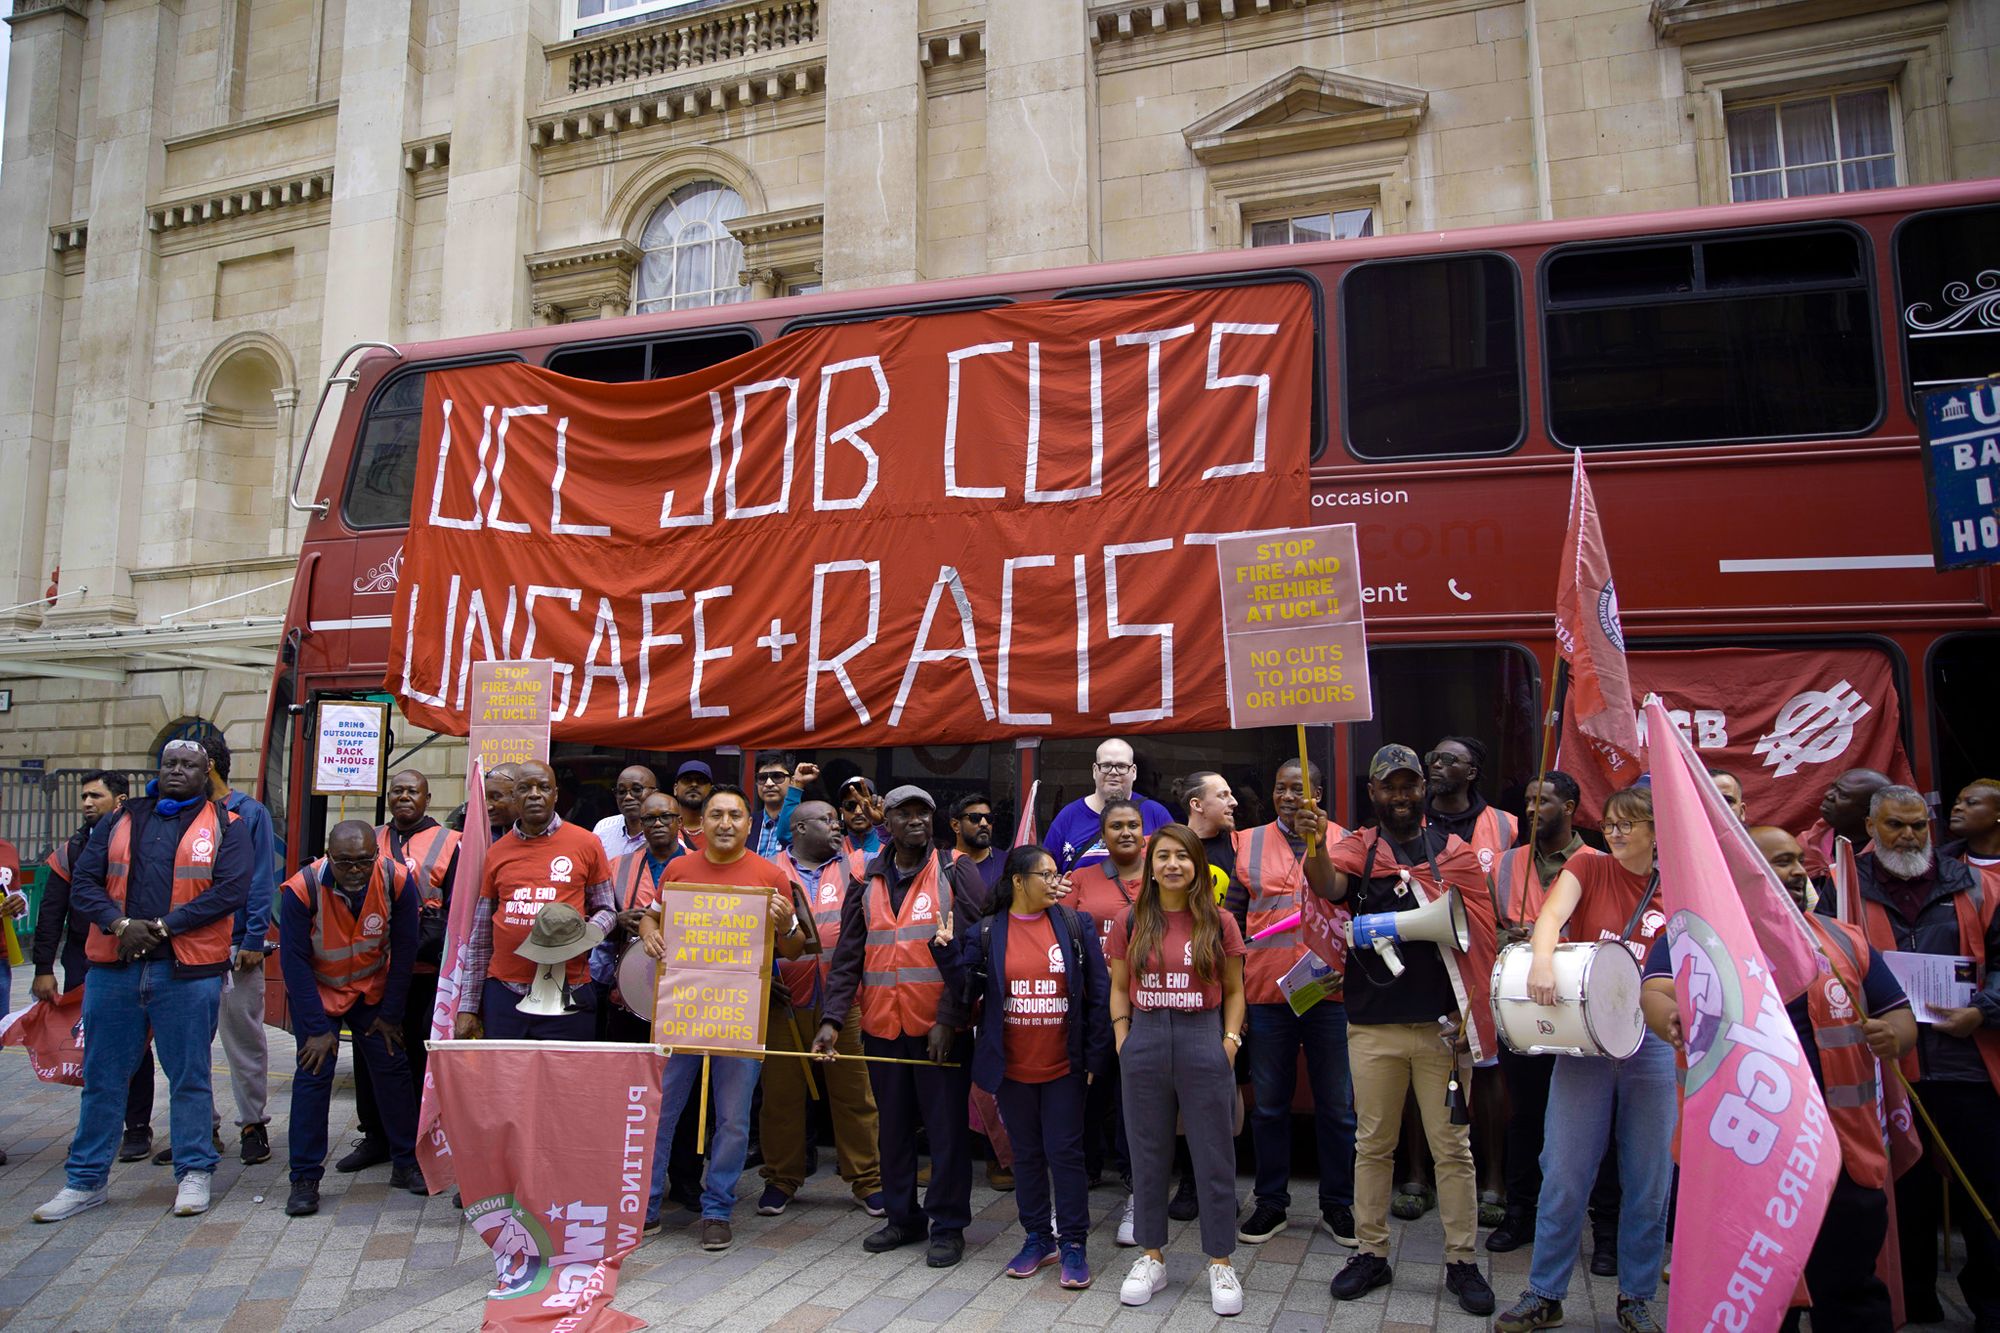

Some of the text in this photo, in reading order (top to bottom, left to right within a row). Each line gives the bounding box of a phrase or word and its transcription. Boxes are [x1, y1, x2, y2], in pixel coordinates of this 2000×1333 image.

[428, 322, 1280, 537] UCL JOB CUTS
[1310, 488, 1409, 507] occasion
[1256, 539, 1316, 561] STOP
[1236, 557, 1341, 583] FIRE-AND
[1247, 578, 1335, 601] -REHIRE
[1361, 582, 1408, 603] ent
[1246, 604, 1276, 623] AT
[1280, 600, 1324, 620] UCL
[1250, 644, 1343, 668] NO CUTS
[494, 667, 529, 679] STOP
[1255, 665, 1343, 688] TO JOBS
[481, 681, 542, 693] FIRE-AND
[1246, 684, 1356, 709] OR HOURS
[483, 709, 499, 720] AT
[503, 709, 528, 720] UCL
[323, 730, 379, 738] OUTSOURCED
[337, 739, 364, 747] STAFF
[481, 739, 535, 751] NO CUTS
[324, 756, 375, 765] IN-HOUSE
[336, 748, 363, 756] BACK
[483, 752, 498, 765] TO
[513, 887, 557, 900] UCL END
[693, 895, 741, 910] STOP
[673, 912, 759, 929] FIRE-AND
[680, 930, 750, 947] -REHIRE
[675, 947, 700, 962] AT
[703, 949, 738, 964] UCL
[1011, 980, 1057, 995] UCL END
[1141, 973, 1189, 989] UCL END
[672, 985, 749, 1004] NO CUTS
[673, 1003, 745, 1022] TO JOBS
[662, 1021, 753, 1040] OR HOURS
